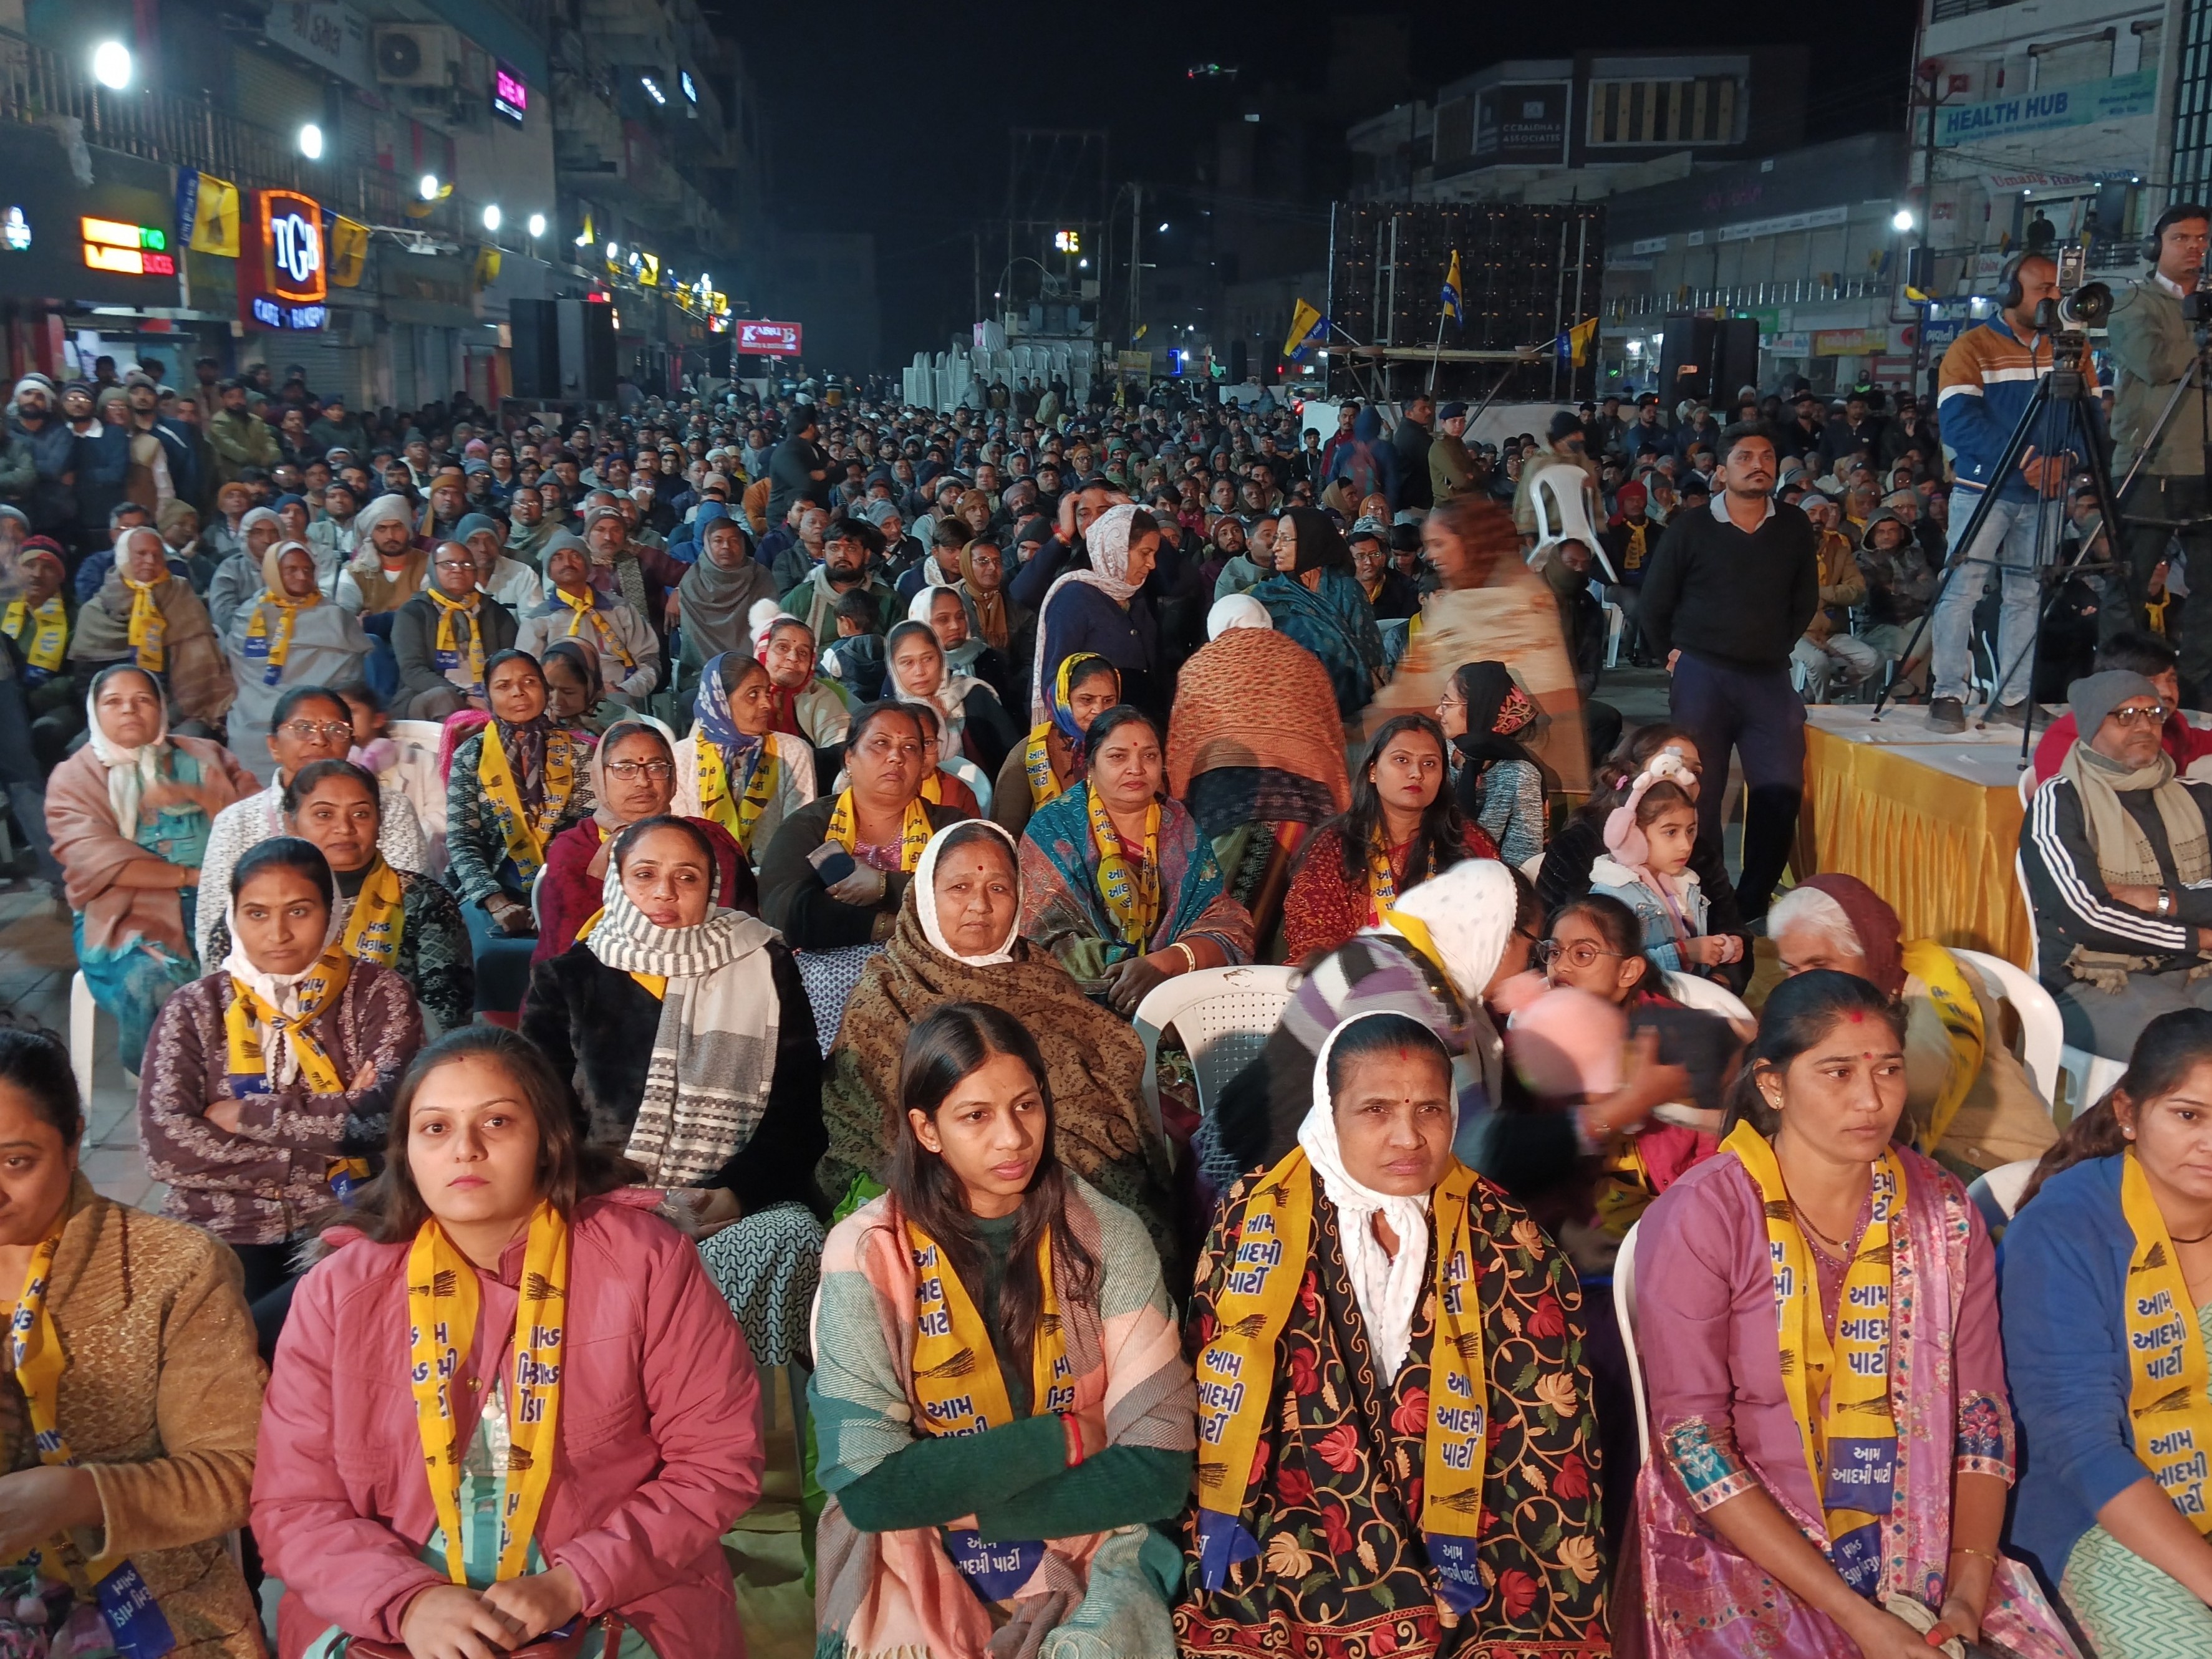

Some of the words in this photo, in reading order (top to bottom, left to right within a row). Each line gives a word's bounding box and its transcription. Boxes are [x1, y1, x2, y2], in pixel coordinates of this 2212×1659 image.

[1946, 100, 2021, 133] HEALTH
[2025, 92, 2069, 119] HUB
[1991, 171, 2046, 188] Umang
[271, 213, 320, 282] TGB
[2137, 1289, 2174, 1316] આમ
[2133, 1310, 2187, 1350] આદમી
[1204, 1347, 1243, 1378] આમ
[2146, 1344, 2184, 1380] પાર્ટી
[927, 1394, 973, 1421] આમ
[1436, 1403, 1485, 1438] આદમી
[1441, 1436, 1478, 1470] પાર્ટી
[1853, 1446, 1881, 1463] આમ
[2149, 1428, 2194, 1455] આમ
[1830, 1463, 1872, 1486] આદમી
[1873, 1461, 1891, 1484] પાર્ટી
[992, 1547, 1021, 1573] પાર્ટી
[1442, 1543, 1463, 1561] આમ
